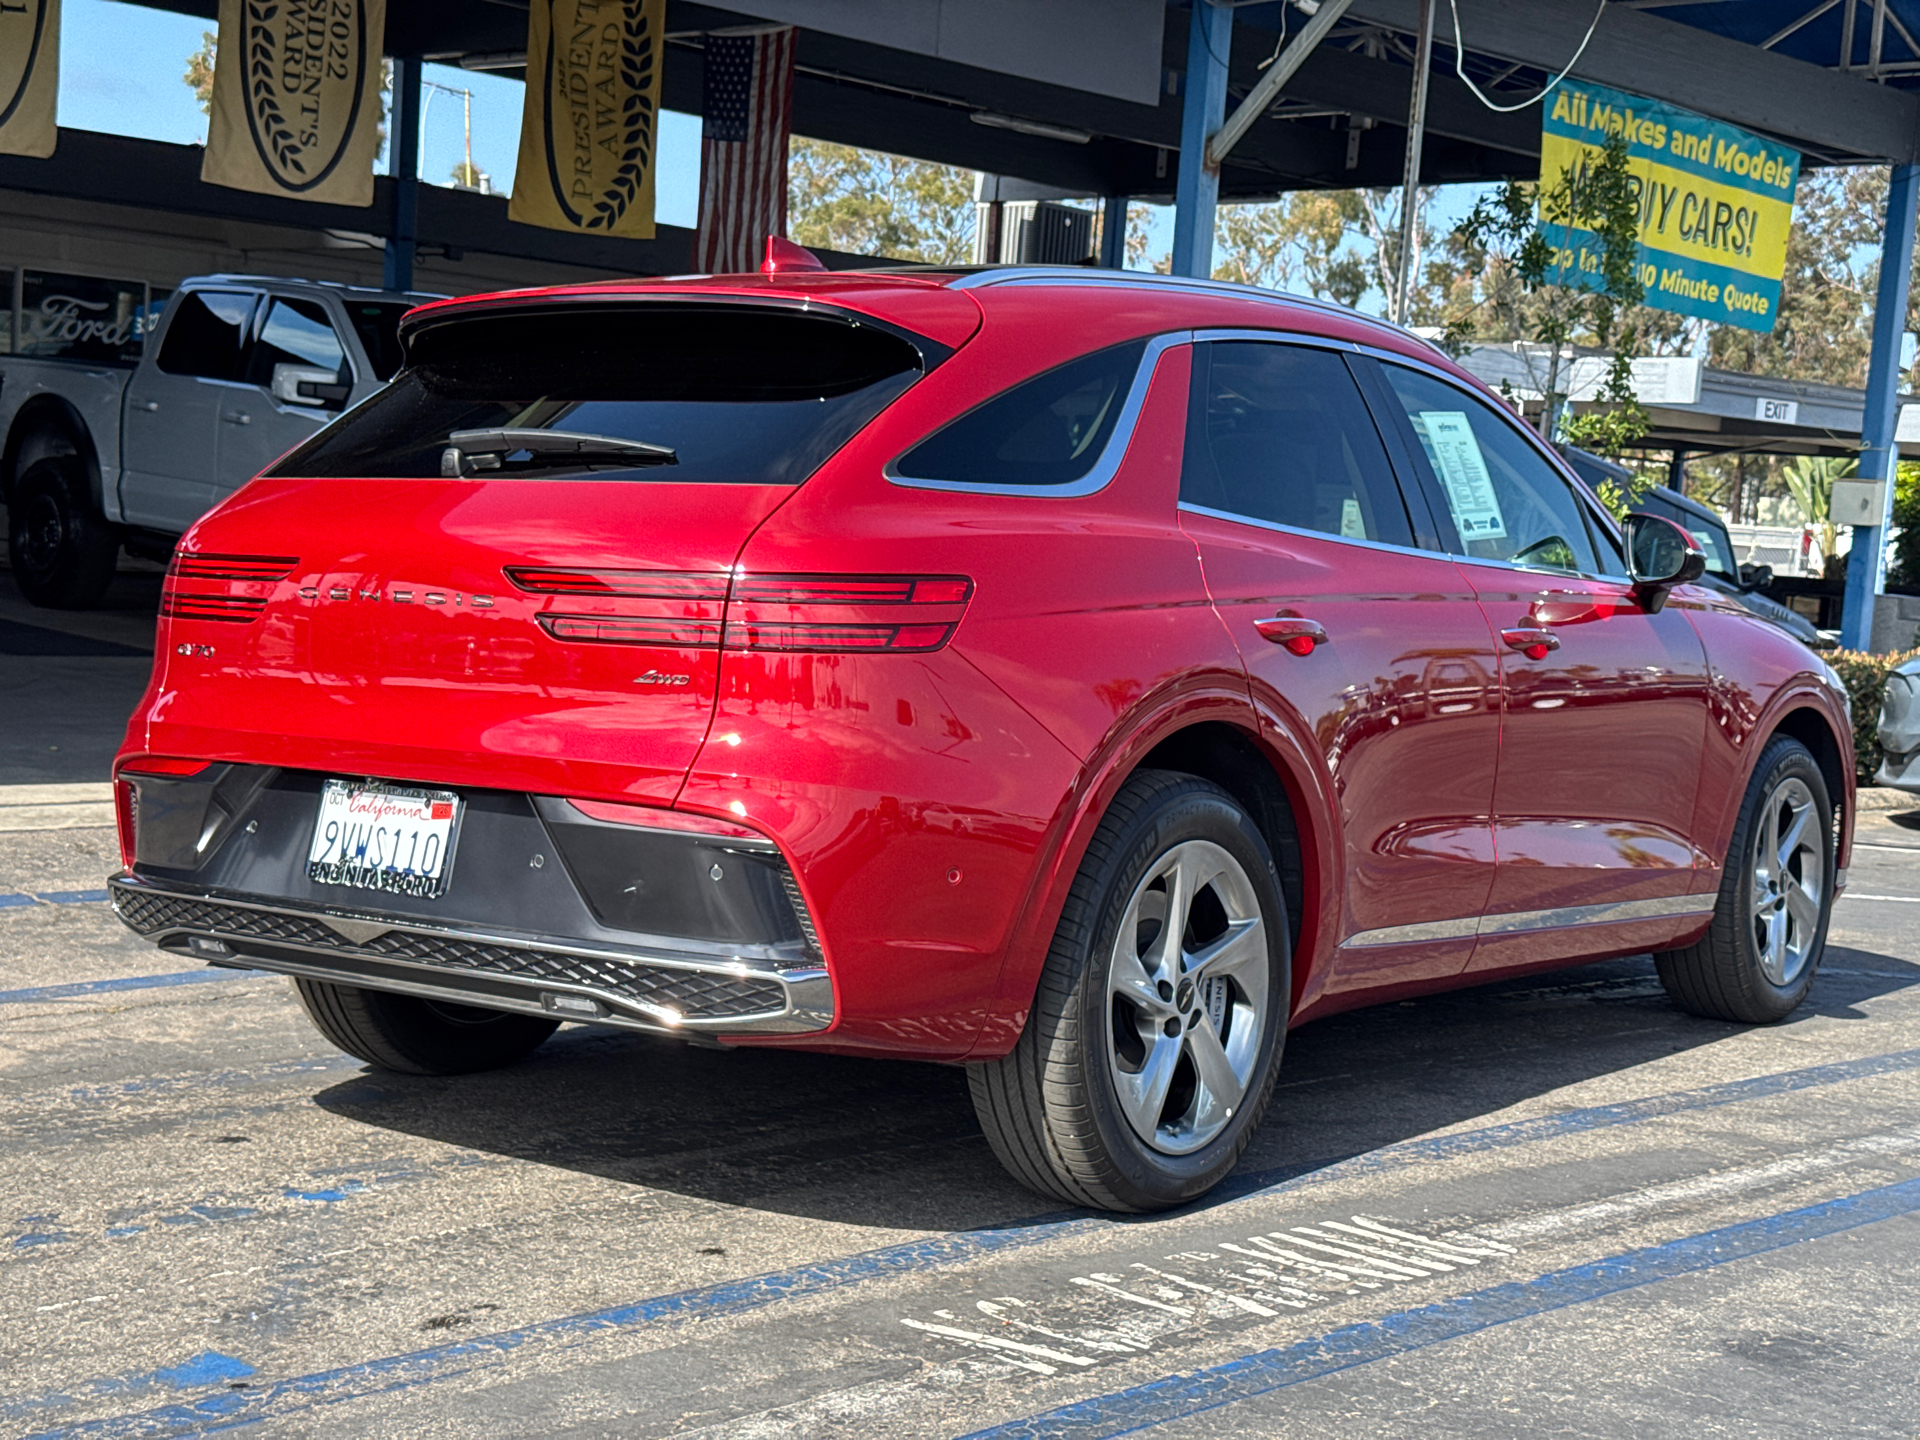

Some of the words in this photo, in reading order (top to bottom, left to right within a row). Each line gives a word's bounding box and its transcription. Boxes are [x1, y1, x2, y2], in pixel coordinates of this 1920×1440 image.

[326, 1, 352, 81] 2022
[594, 22, 620, 160] AWARD
[1551, 90, 1588, 127] All
[1589, 100, 1667, 149] Makes
[1670, 129, 1713, 165] and
[1714, 139, 1792, 190] Models
[1624, 173, 1679, 235] BUY
[1679, 191, 1759, 257] CARS!
[1659, 268, 1720, 303] Minute
[1722, 283, 1770, 316] Quote
[31, 294, 133, 346] Ford
[1764, 400, 1789, 421] EXIT
[299, 586, 495, 608] GENESIS
[329, 793, 345, 806] OCT
[349, 792, 431, 823] California
[1166, 803, 1200, 826] PRIMACY
[318, 820, 440, 876] 9VWS110
[1100, 829, 1158, 947] MICHELIN
